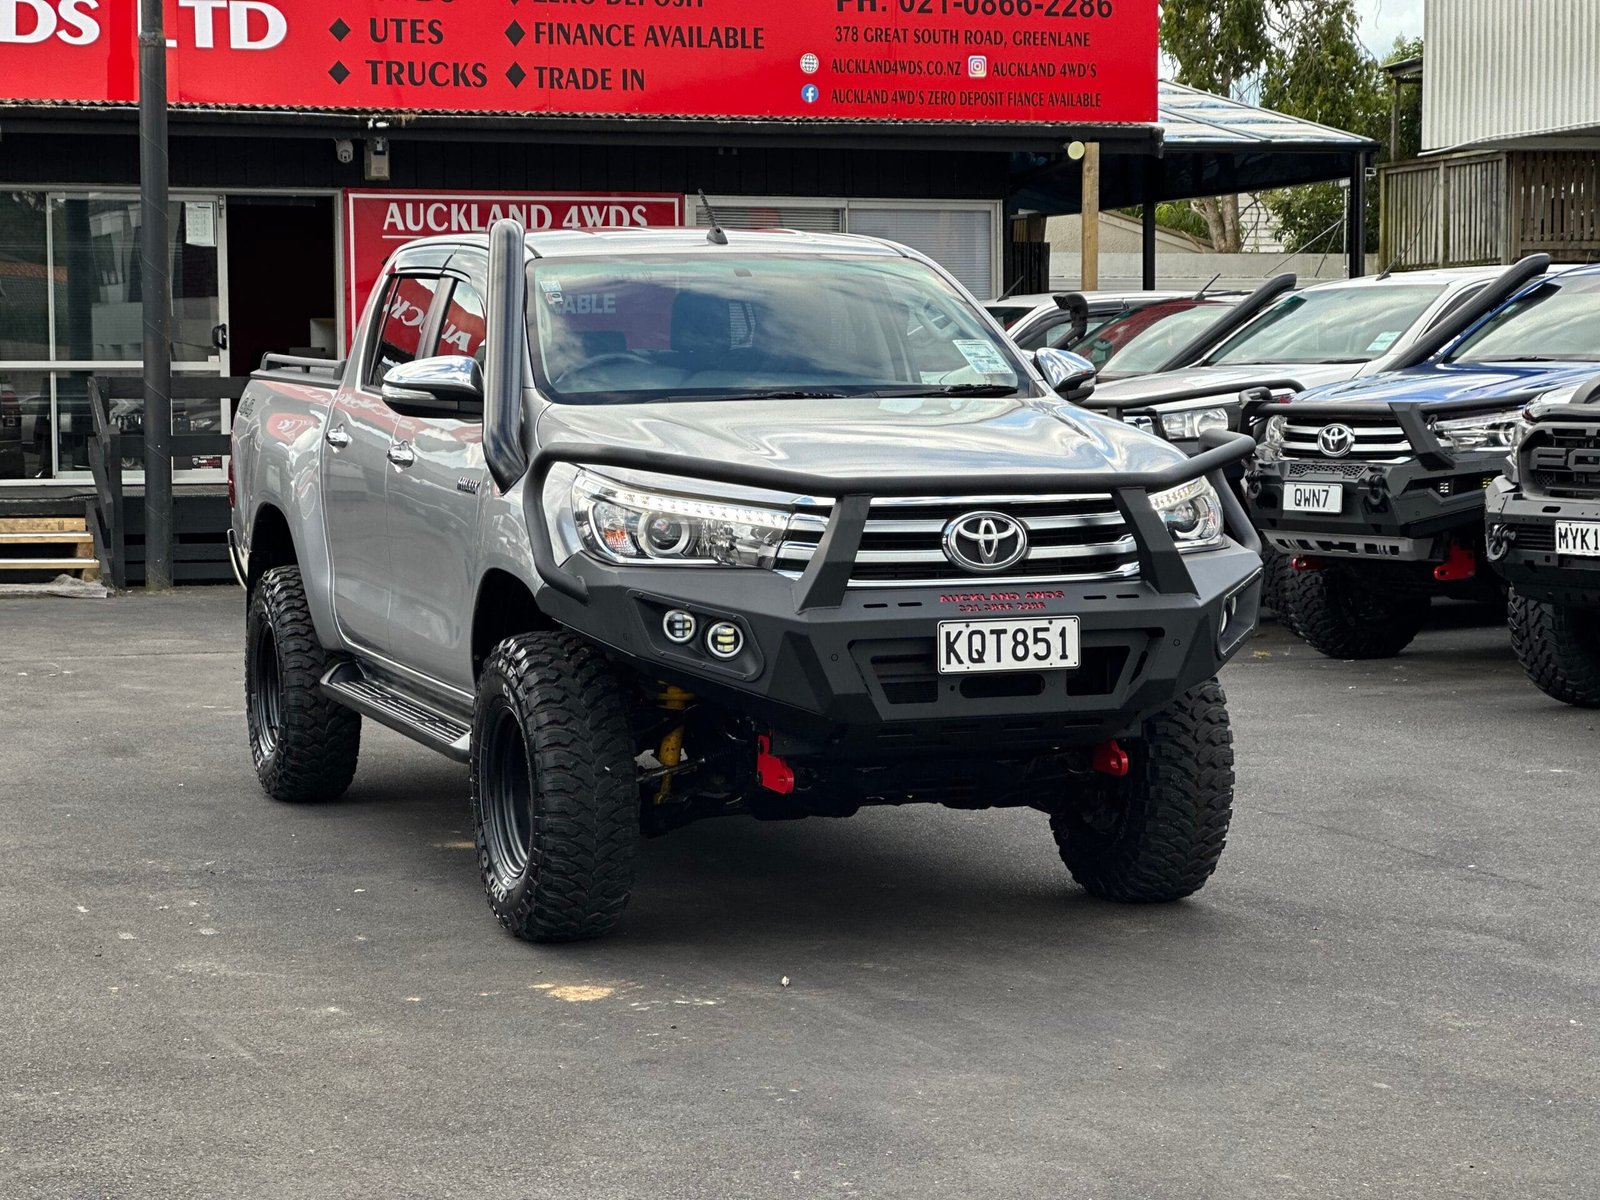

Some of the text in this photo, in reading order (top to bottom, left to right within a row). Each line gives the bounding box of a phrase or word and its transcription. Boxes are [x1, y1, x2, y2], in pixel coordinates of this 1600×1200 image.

[369, 17, 444, 45] UTES
[534, 22, 765, 50] FINANCE AVAILABLE
[835, 26, 1090, 47] 378 GREAT SOUTH ROAD, GREENLANE
[365, 59, 488, 88] TRUCKS
[534, 66, 645, 91] TRADE IN
[831, 58, 1097, 78] AUCKLAND4WDS.CO.NZ AUCKLAND 4WD'S
[831, 88, 888, 104] AUCKLAND
[928, 91, 956, 106] ZERO
[959, 91, 1004, 107] DEPOSIT
[1007, 92, 1044, 107] FIANCE
[1048, 93, 1102, 108] AVAILABLE
[382, 202, 648, 231] AUCKLAND 4WDS
[1294, 488, 1330, 508] QWN7
[940, 590, 1065, 603] AUCKLAND 4WDS
[945, 626, 1069, 665] KQT851
